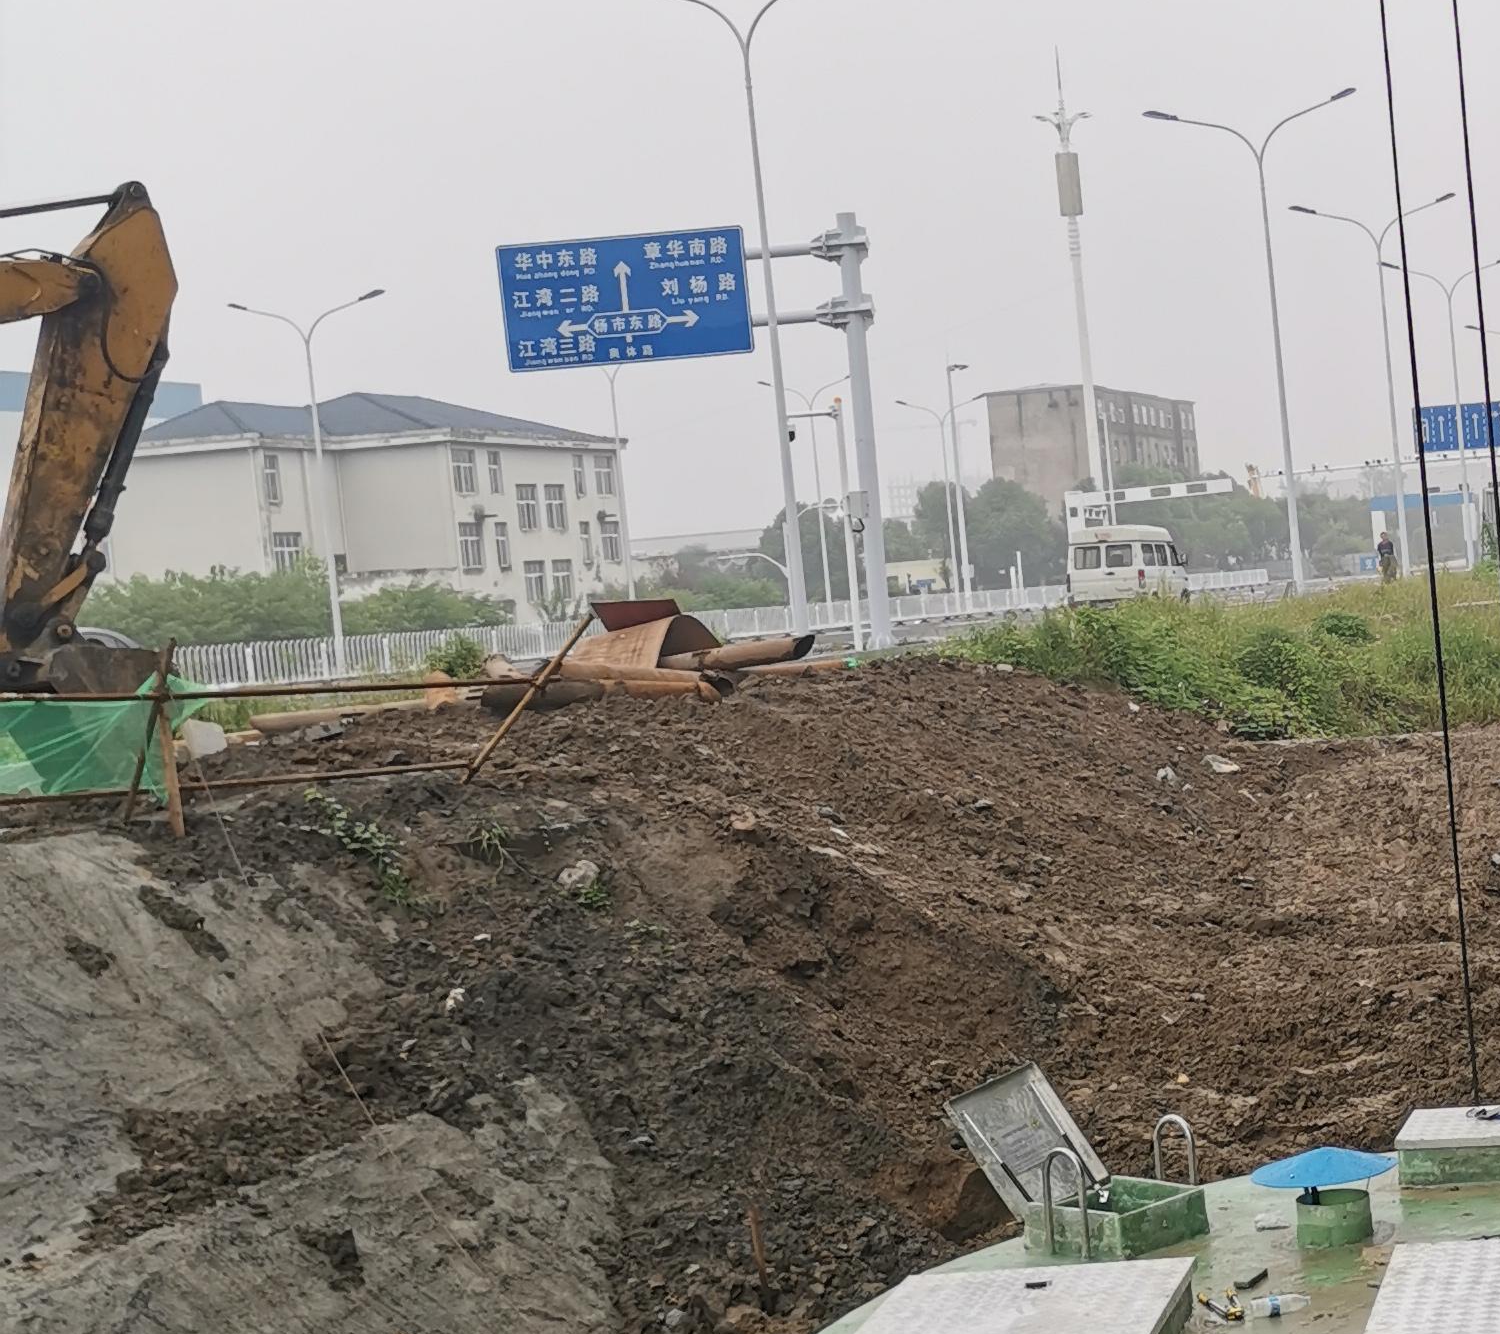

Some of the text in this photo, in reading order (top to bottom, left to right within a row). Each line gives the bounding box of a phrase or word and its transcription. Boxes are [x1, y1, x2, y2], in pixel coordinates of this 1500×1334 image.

[515, 248, 597, 271] 华中东路
[643, 236, 727, 260] 章华南路
[660, 272, 736, 296] 刘杨路
[512, 284, 599, 309] 江湾二路
[519, 334, 596, 358] 江湾三路
